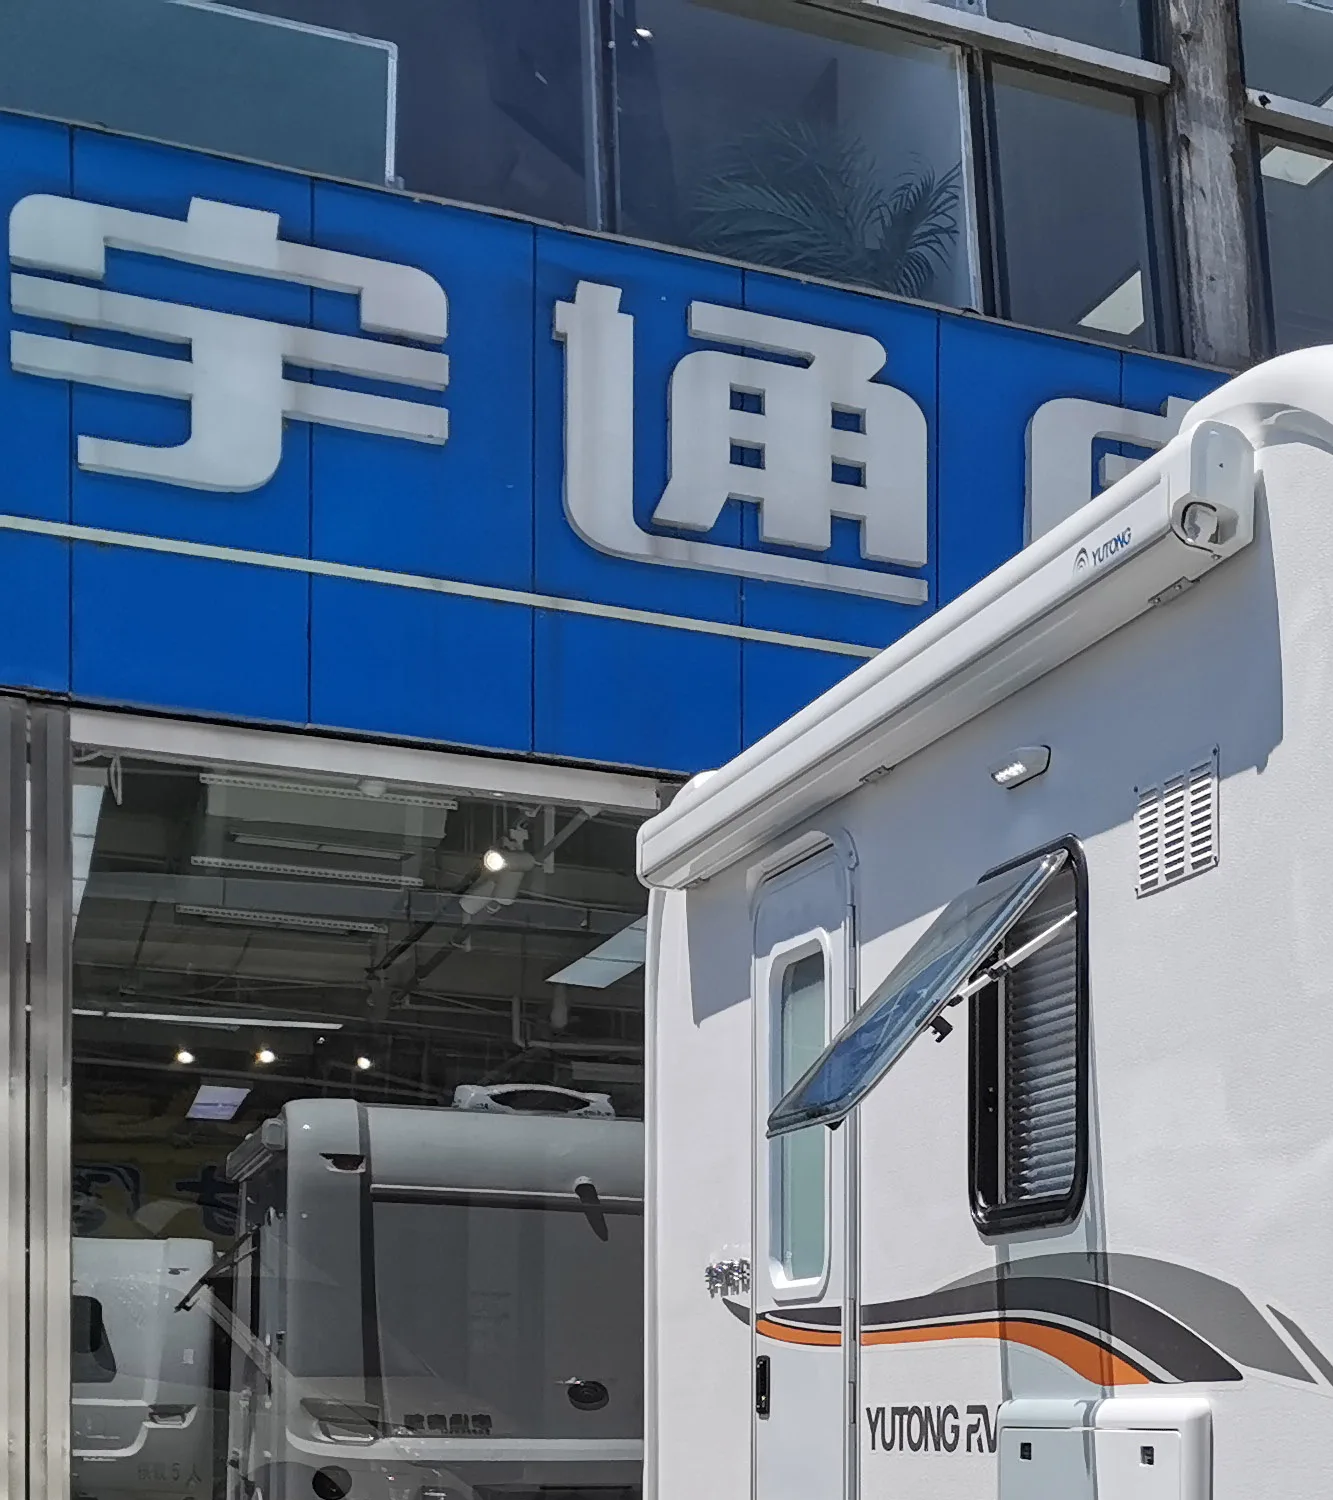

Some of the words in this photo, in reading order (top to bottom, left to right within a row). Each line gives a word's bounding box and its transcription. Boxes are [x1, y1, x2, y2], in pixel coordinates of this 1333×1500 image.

[1091, 526, 1132, 567] YUTONG
[866, 1404, 960, 1454] YUTONG
[966, 1403, 1000, 1454] RV
